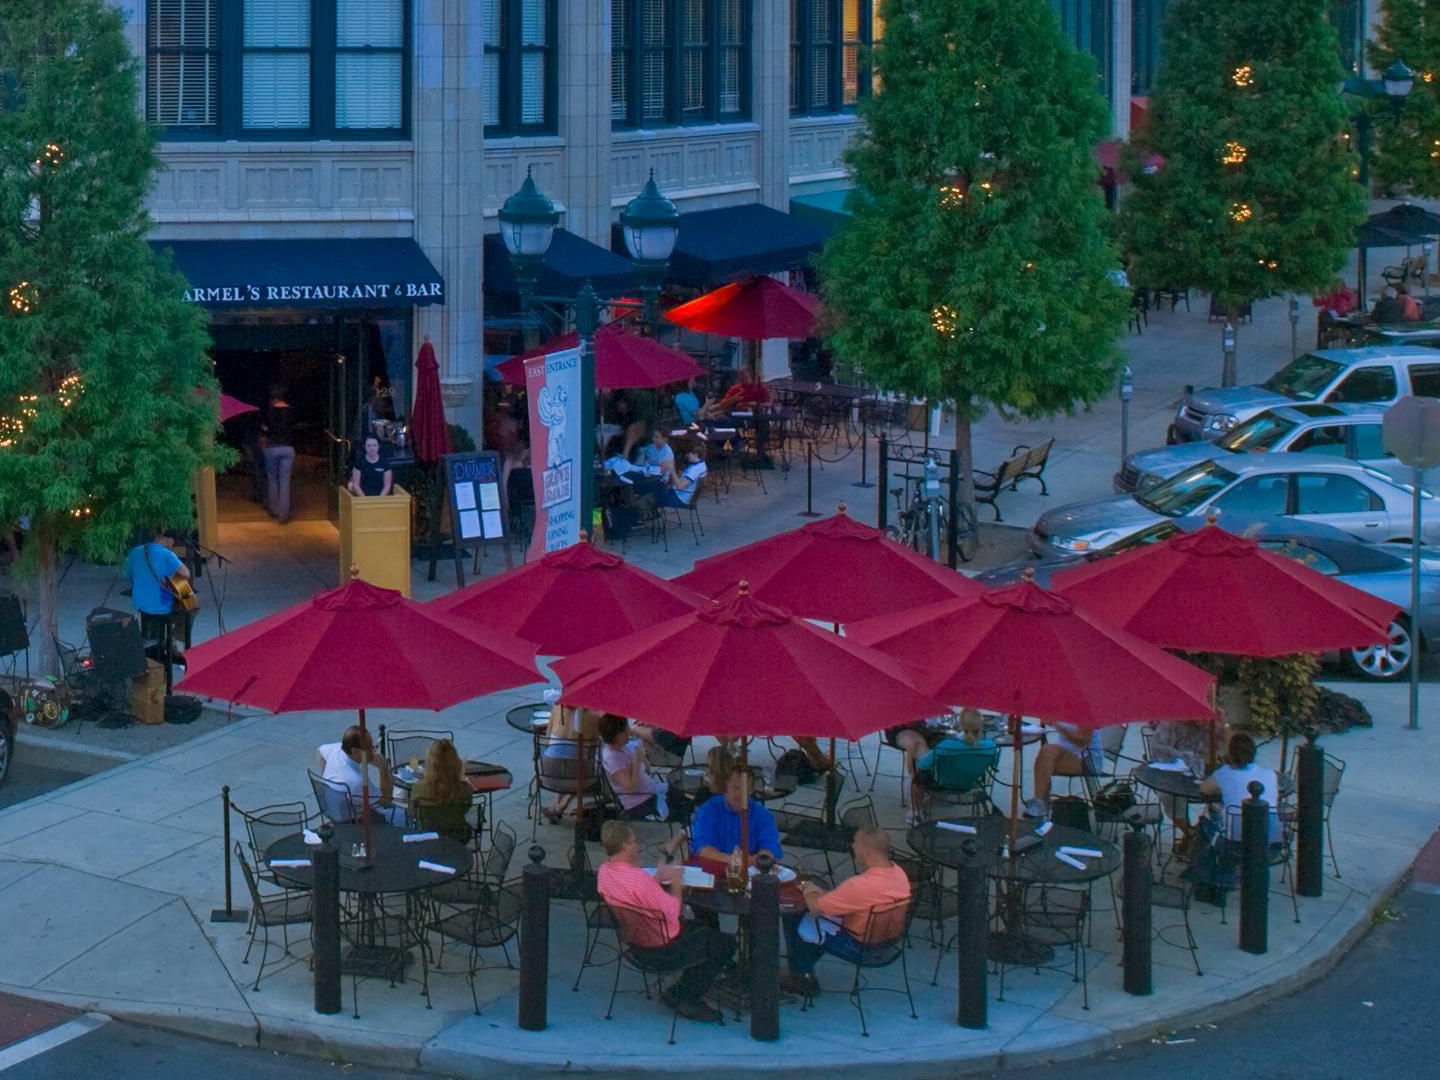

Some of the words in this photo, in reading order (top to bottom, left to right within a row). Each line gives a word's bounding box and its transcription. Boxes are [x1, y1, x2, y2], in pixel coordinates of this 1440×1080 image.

[181, 284, 261, 302] ARMEL'S
[266, 284, 391, 300] RESTAURANT
[406, 282, 442, 297] BAR
[528, 365, 545, 378] EAST
[546, 357, 577, 374] ENTRANCE
[549, 511, 576, 526] SHOPPING
